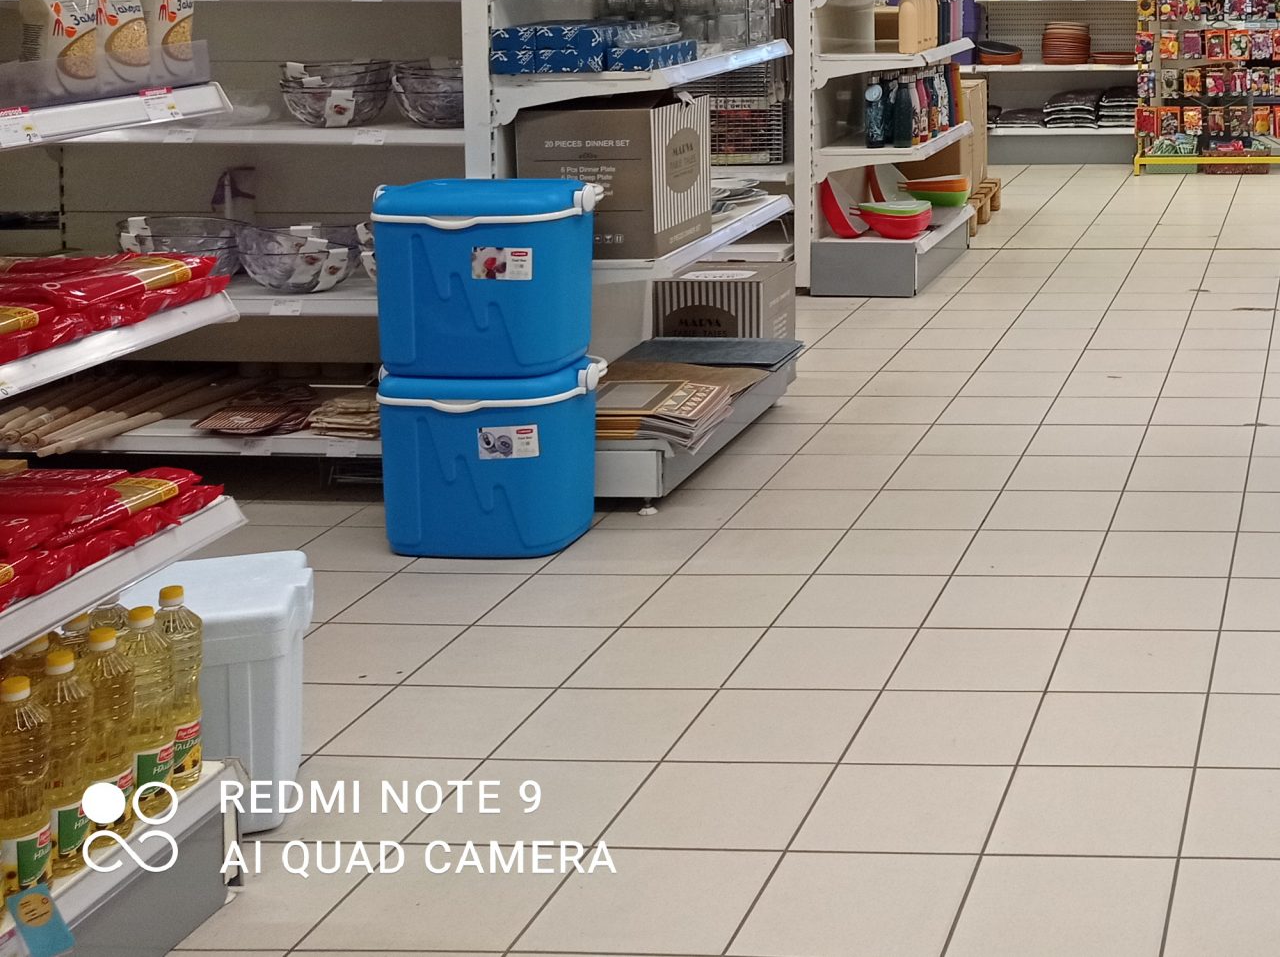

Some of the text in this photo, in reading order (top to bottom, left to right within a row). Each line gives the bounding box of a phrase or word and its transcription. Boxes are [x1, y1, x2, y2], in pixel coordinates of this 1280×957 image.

[544, 140, 554, 148] 20
[555, 140, 582, 148] PIECES
[615, 139, 630, 147] SET
